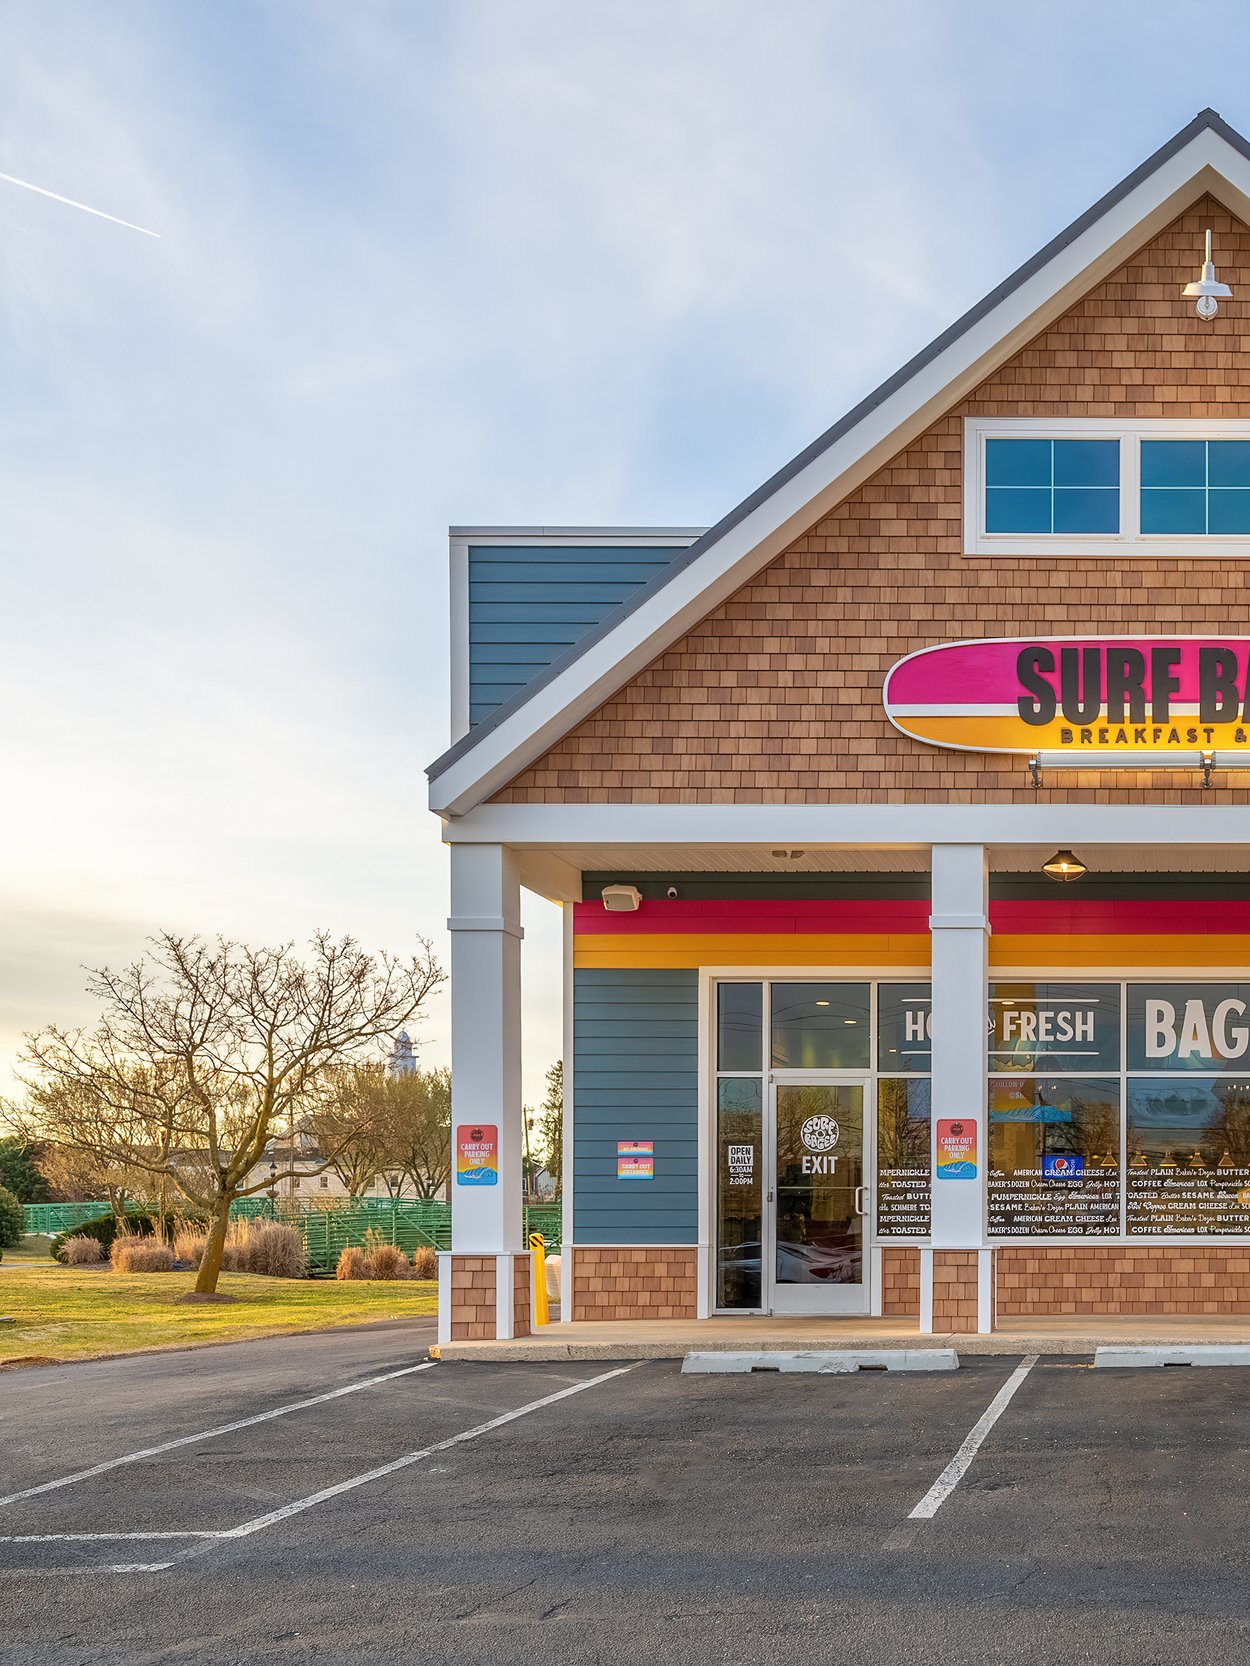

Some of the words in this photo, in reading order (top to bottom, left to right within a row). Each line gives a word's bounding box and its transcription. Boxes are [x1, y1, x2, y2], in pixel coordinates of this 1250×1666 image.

[1015, 645, 1181, 726] SURF
[1060, 727, 1215, 744] BREAKFAST
[1235, 727, 1248, 744] &
[1003, 1011, 1095, 1042] FRESH
[804, 1117, 837, 1134] SURF
[804, 1133, 836, 1150] BAGEL
[731, 1147, 751, 1155] OPEN
[731, 1156, 751, 1165] DAILY
[802, 1156, 838, 1174] EXIT
